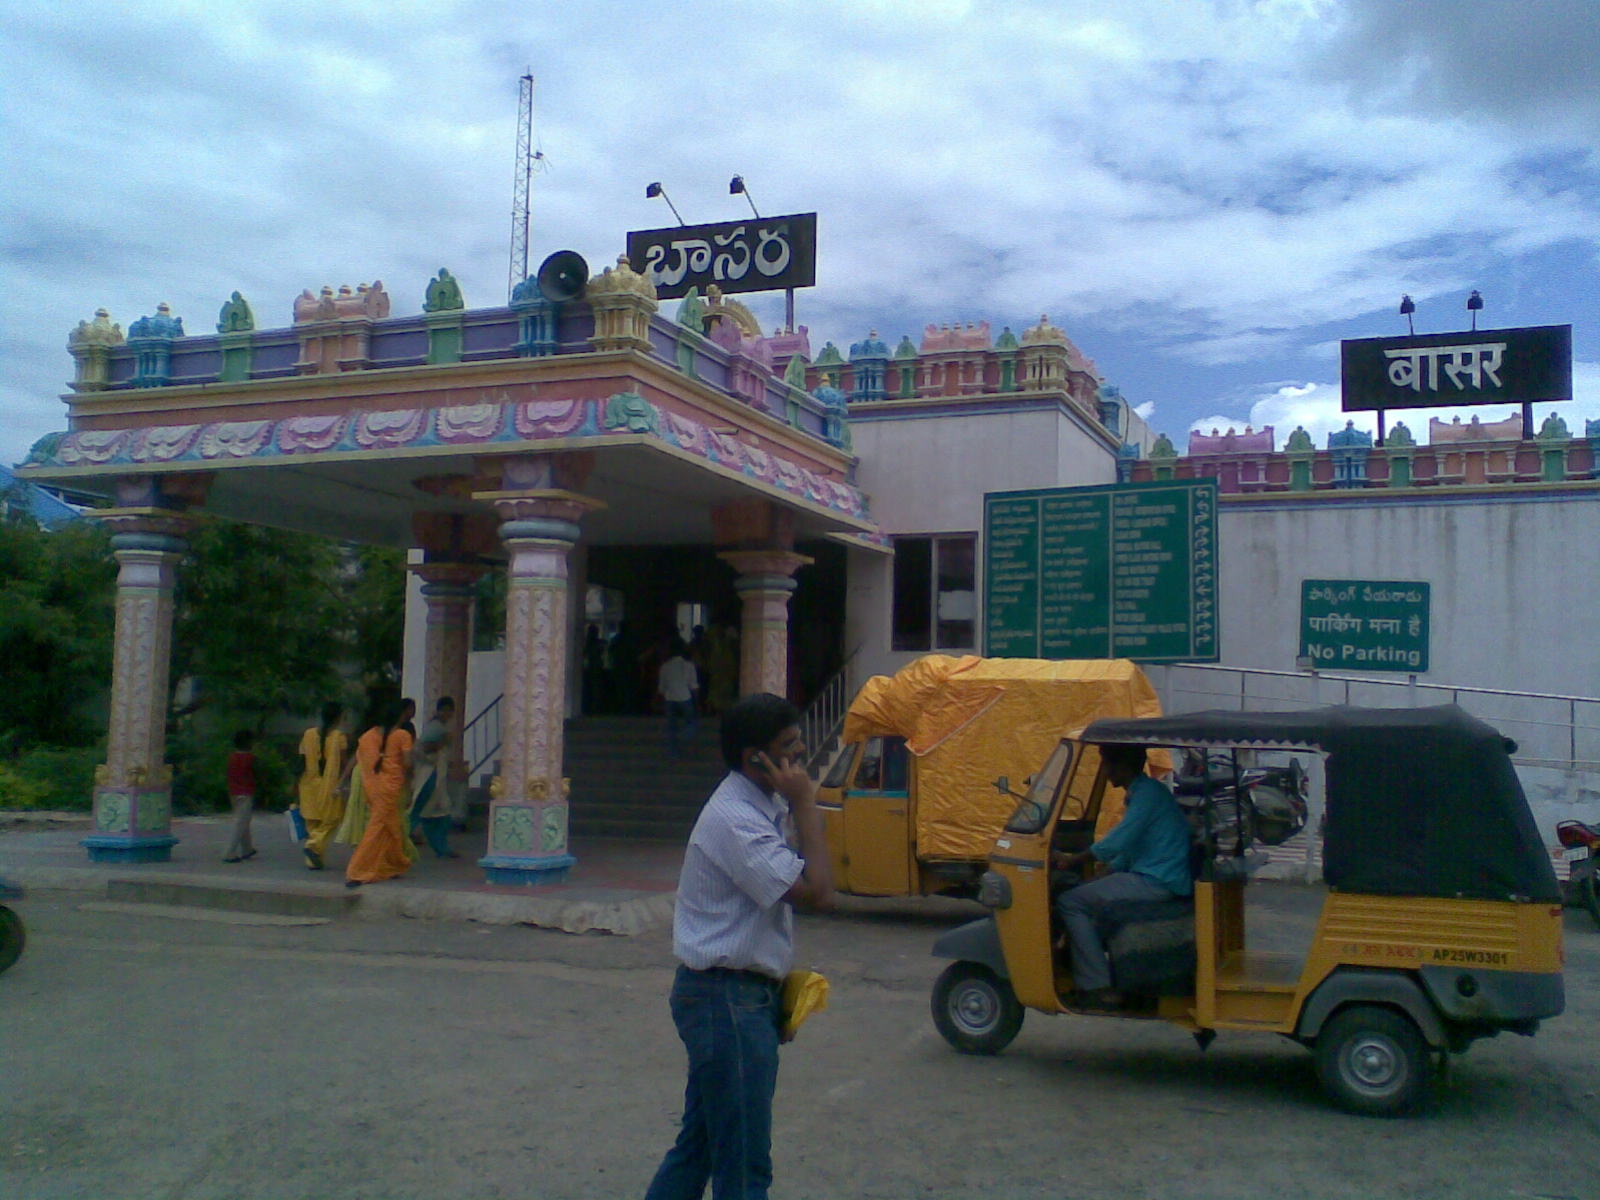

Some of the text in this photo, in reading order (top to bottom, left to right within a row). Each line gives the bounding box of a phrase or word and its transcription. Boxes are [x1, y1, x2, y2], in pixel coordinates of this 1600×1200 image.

[646, 226, 790, 287] బాసర
[1384, 342, 1507, 392] बासर
[1369, 619, 1401, 634] मना
[1408, 614, 1421, 637] है
[1308, 644, 1420, 666] No Parking
